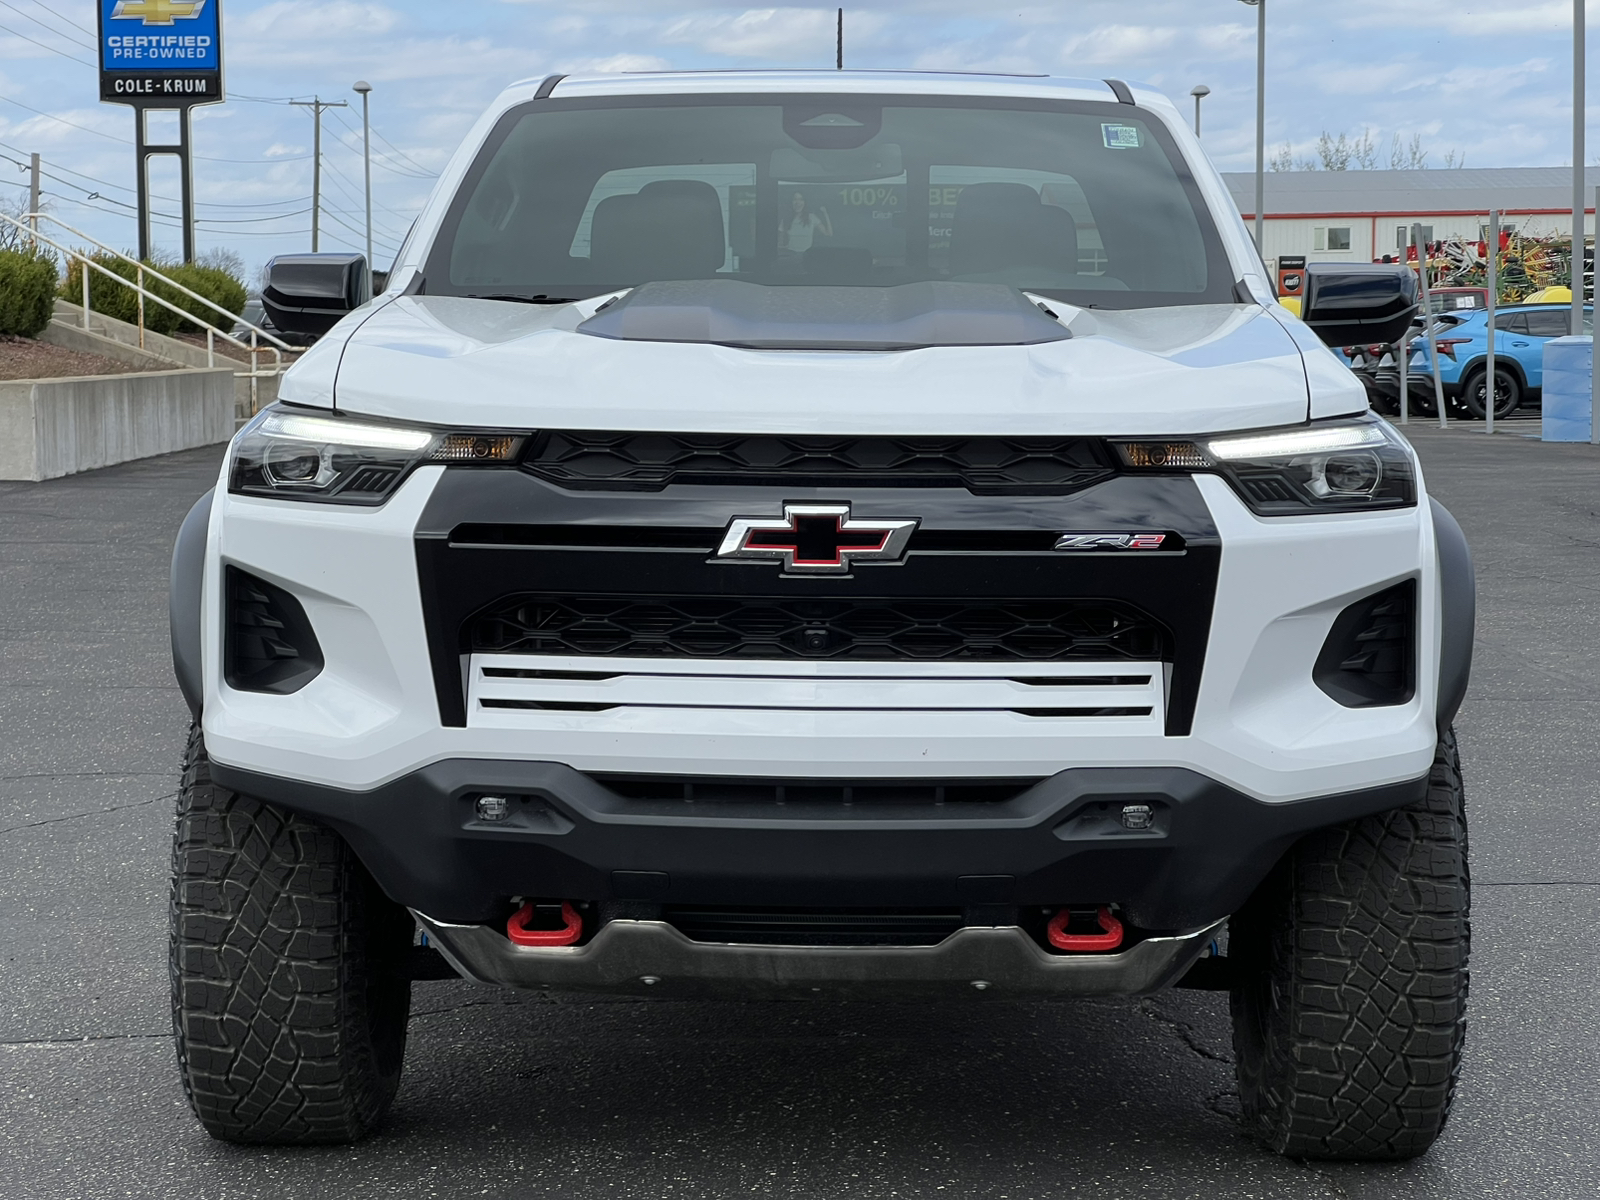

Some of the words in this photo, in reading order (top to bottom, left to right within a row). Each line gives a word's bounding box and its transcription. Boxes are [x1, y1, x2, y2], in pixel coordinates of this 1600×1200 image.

[108, 36, 211, 47] CERTIFIED
[113, 48, 207, 58] PRE-OWNED
[115, 79, 207, 93] COLE-KRUM
[839, 187, 898, 206] 100%
[928, 187, 963, 206] BE
[1054, 534, 1166, 549] ZR2
